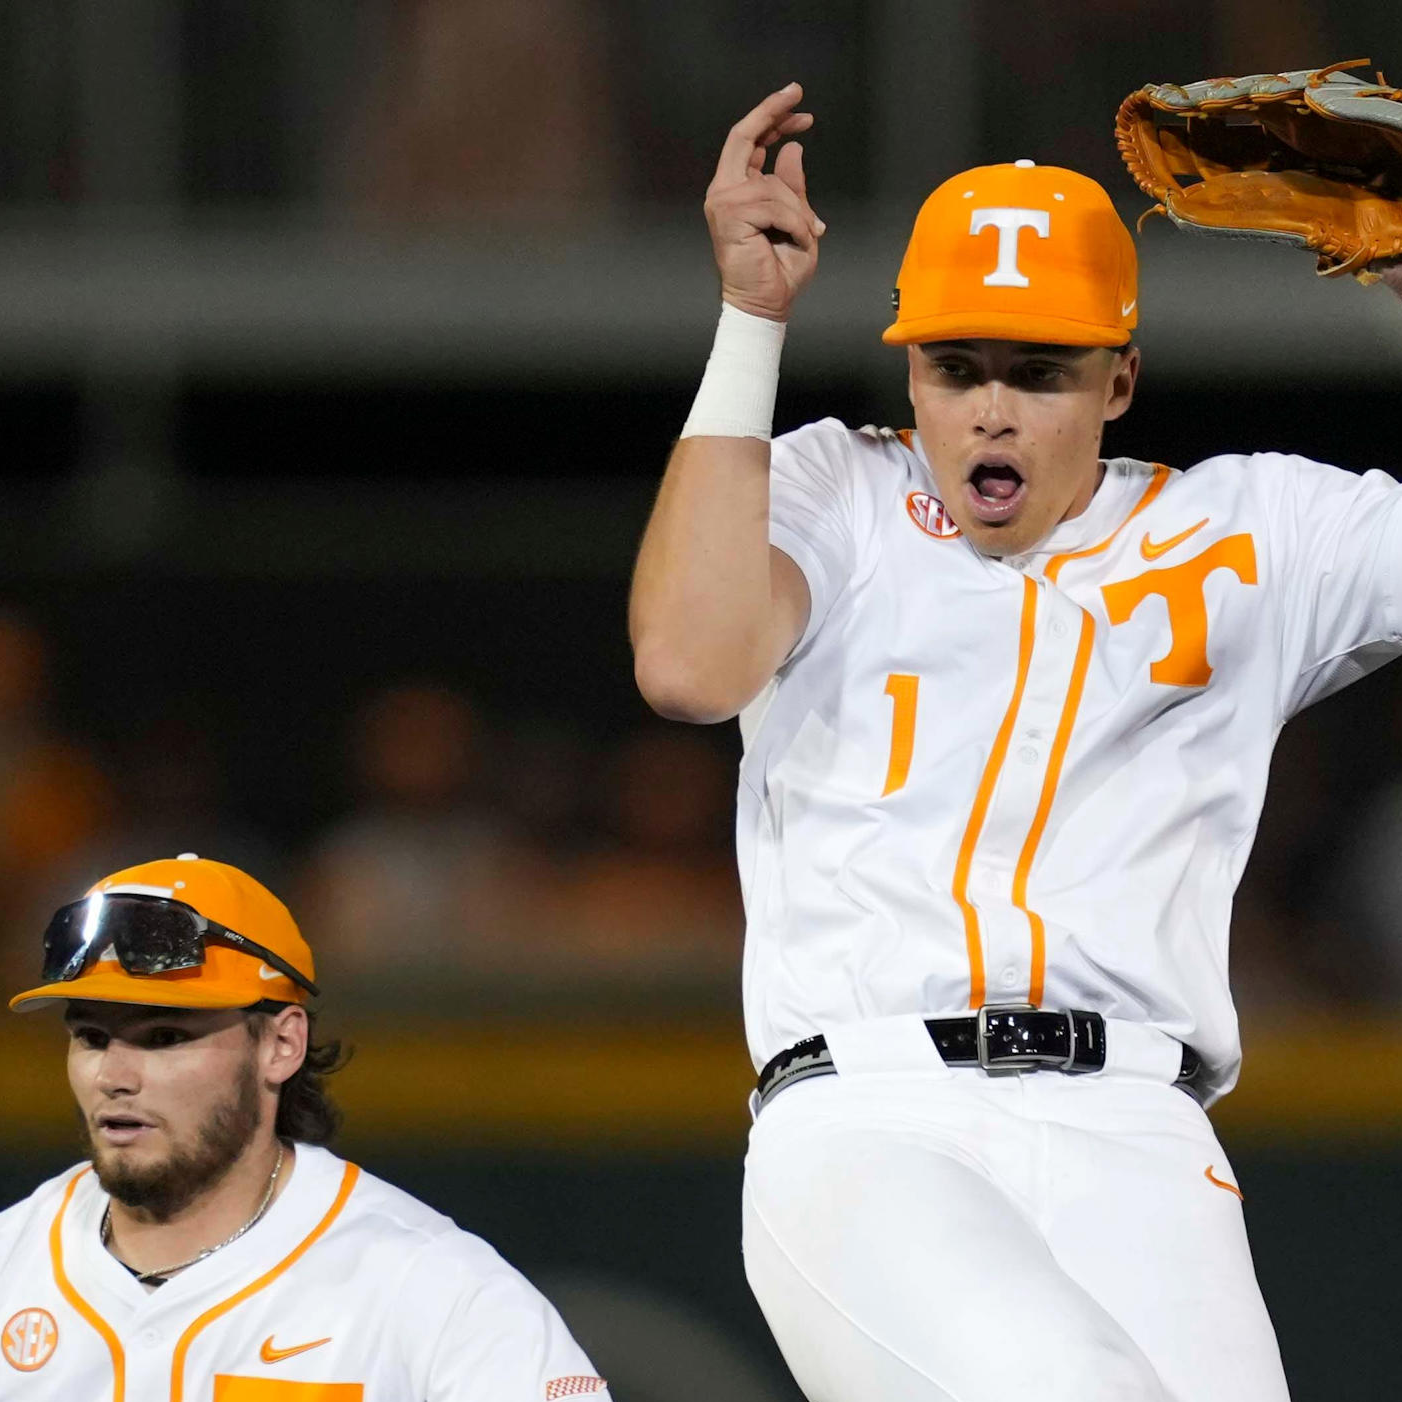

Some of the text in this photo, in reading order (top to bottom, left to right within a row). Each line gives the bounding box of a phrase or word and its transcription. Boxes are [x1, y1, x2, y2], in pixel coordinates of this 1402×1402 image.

[970, 207, 1050, 287] T
[1101, 533, 1258, 687] T
[883, 674, 919, 797] 1
[5, 1311, 56, 1366] SEC
